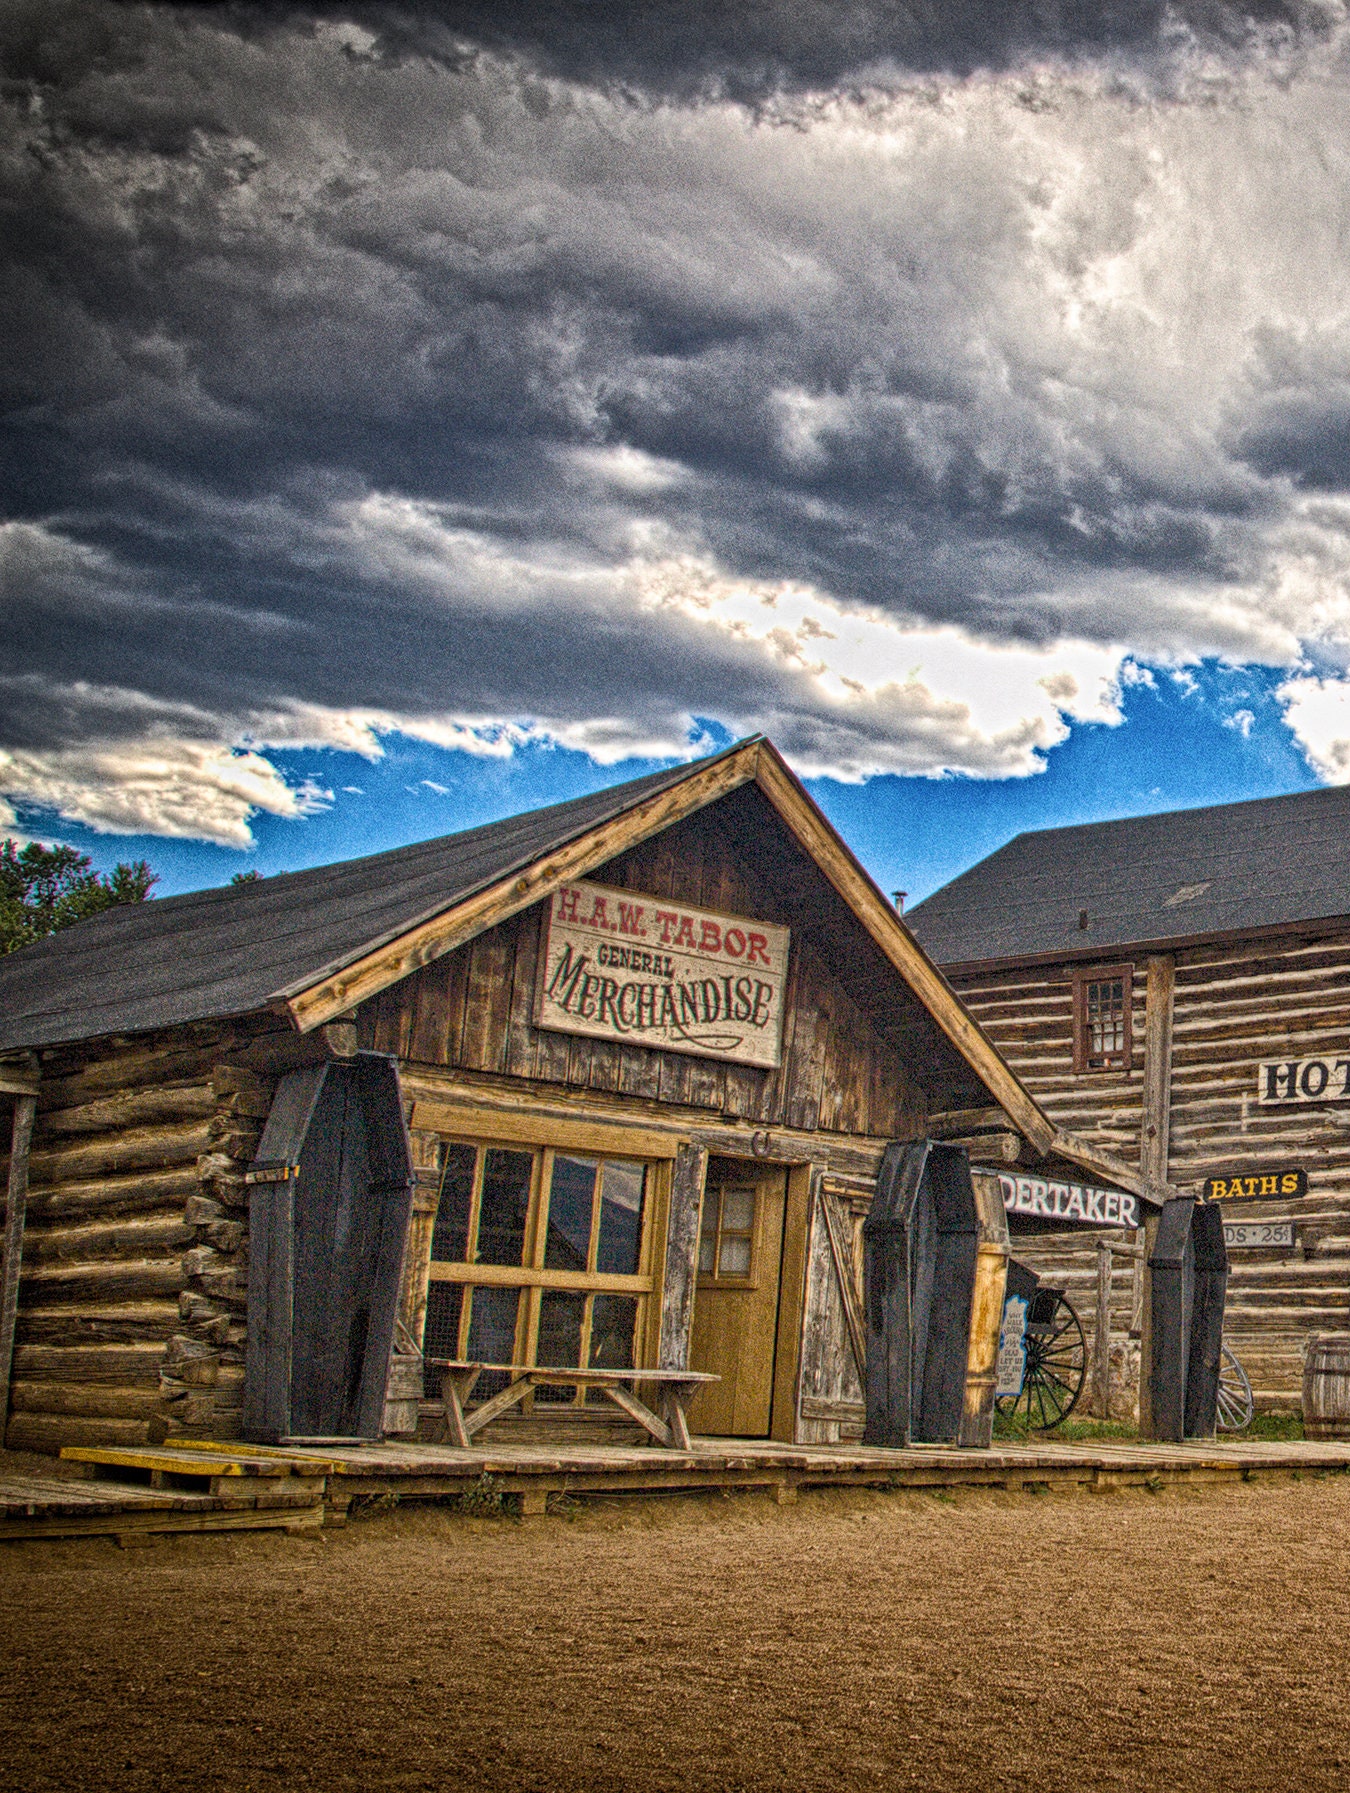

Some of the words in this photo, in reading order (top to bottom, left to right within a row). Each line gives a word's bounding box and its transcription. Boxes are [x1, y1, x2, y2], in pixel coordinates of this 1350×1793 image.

[557, 887, 647, 937] H.A.W.
[655, 909, 772, 966] TABOR
[597, 943, 675, 978] GENERAL
[546, 942, 774, 1049] MERCHANDISE
[998, 1174, 1139, 1227] DERTAKER
[1208, 1173, 1299, 1200] BATHS
[1224, 1227, 1247, 1243] DS
